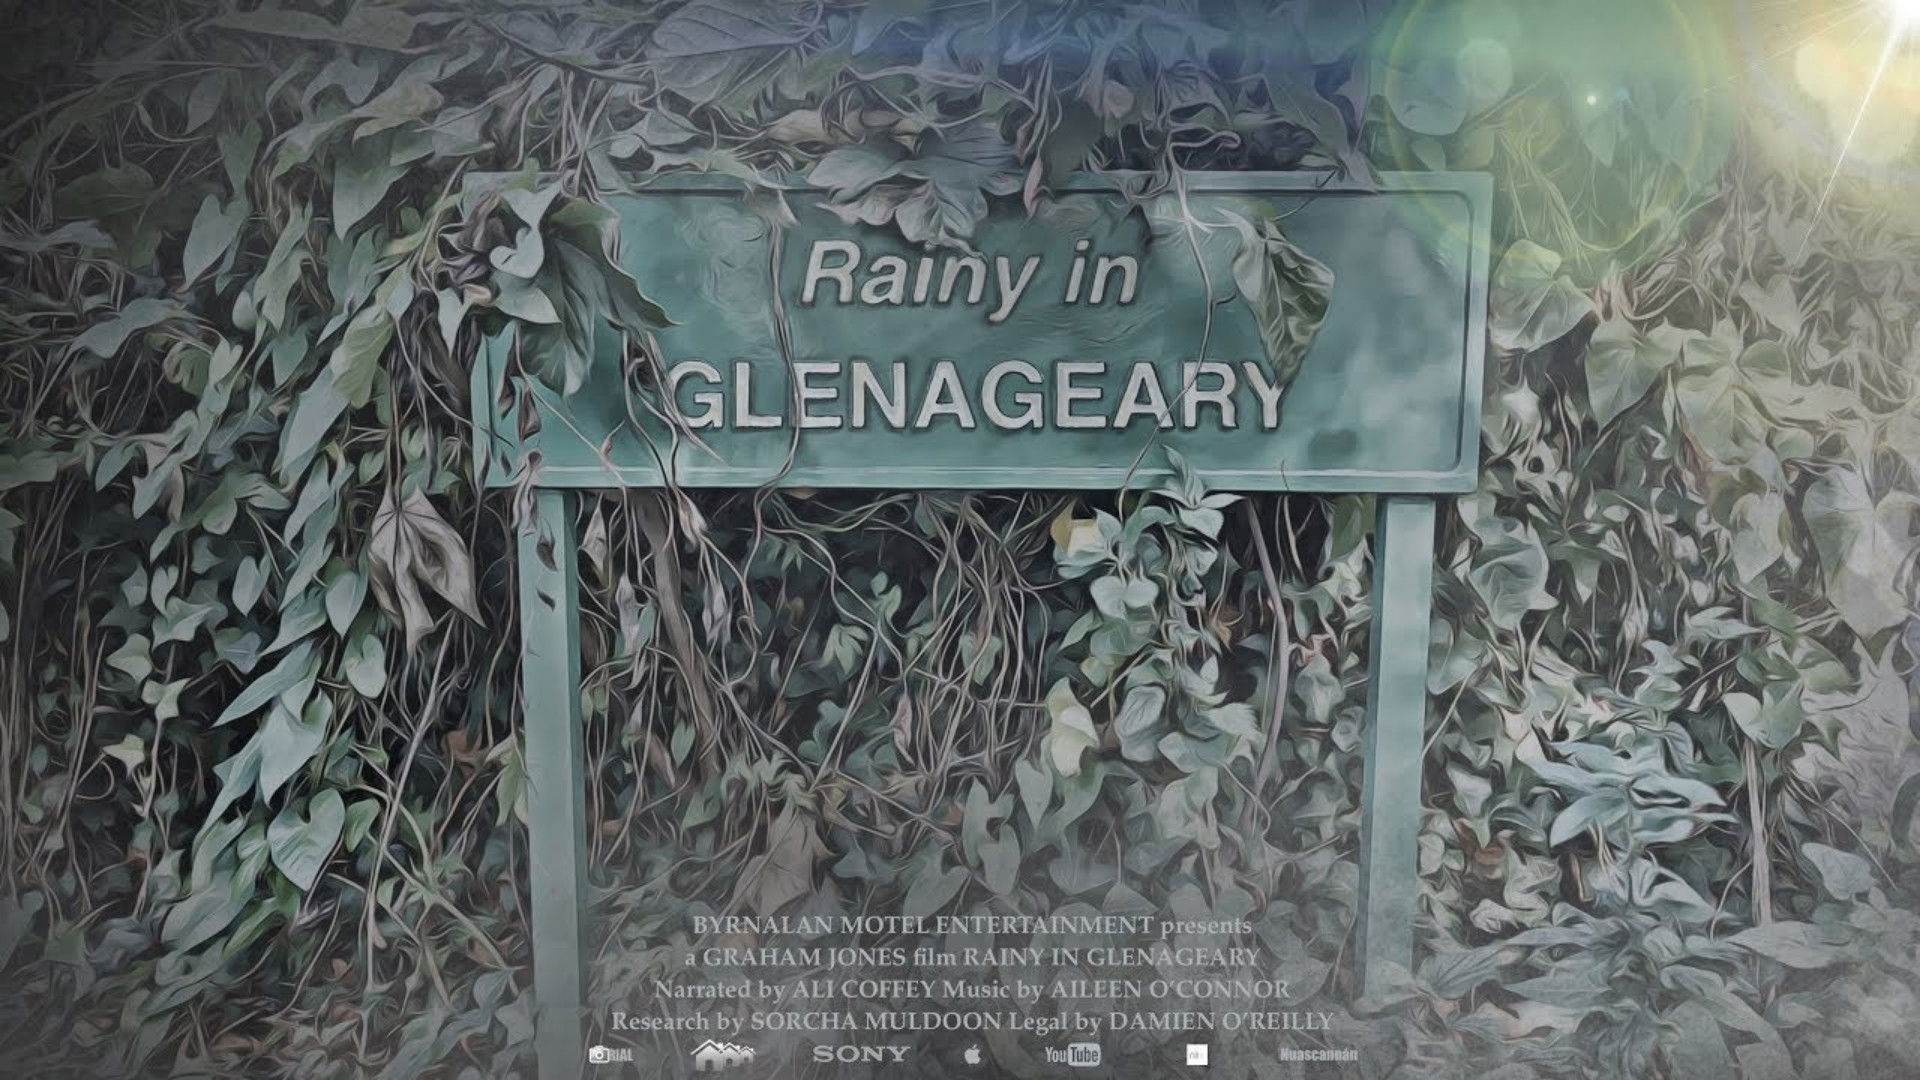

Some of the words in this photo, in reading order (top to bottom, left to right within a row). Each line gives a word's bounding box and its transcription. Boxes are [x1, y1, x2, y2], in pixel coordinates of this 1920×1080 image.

[801, 239, 1040, 324] Rainy
[1064, 239, 1139, 304] in
[670, 360, 1285, 430] GLENAGEARY
